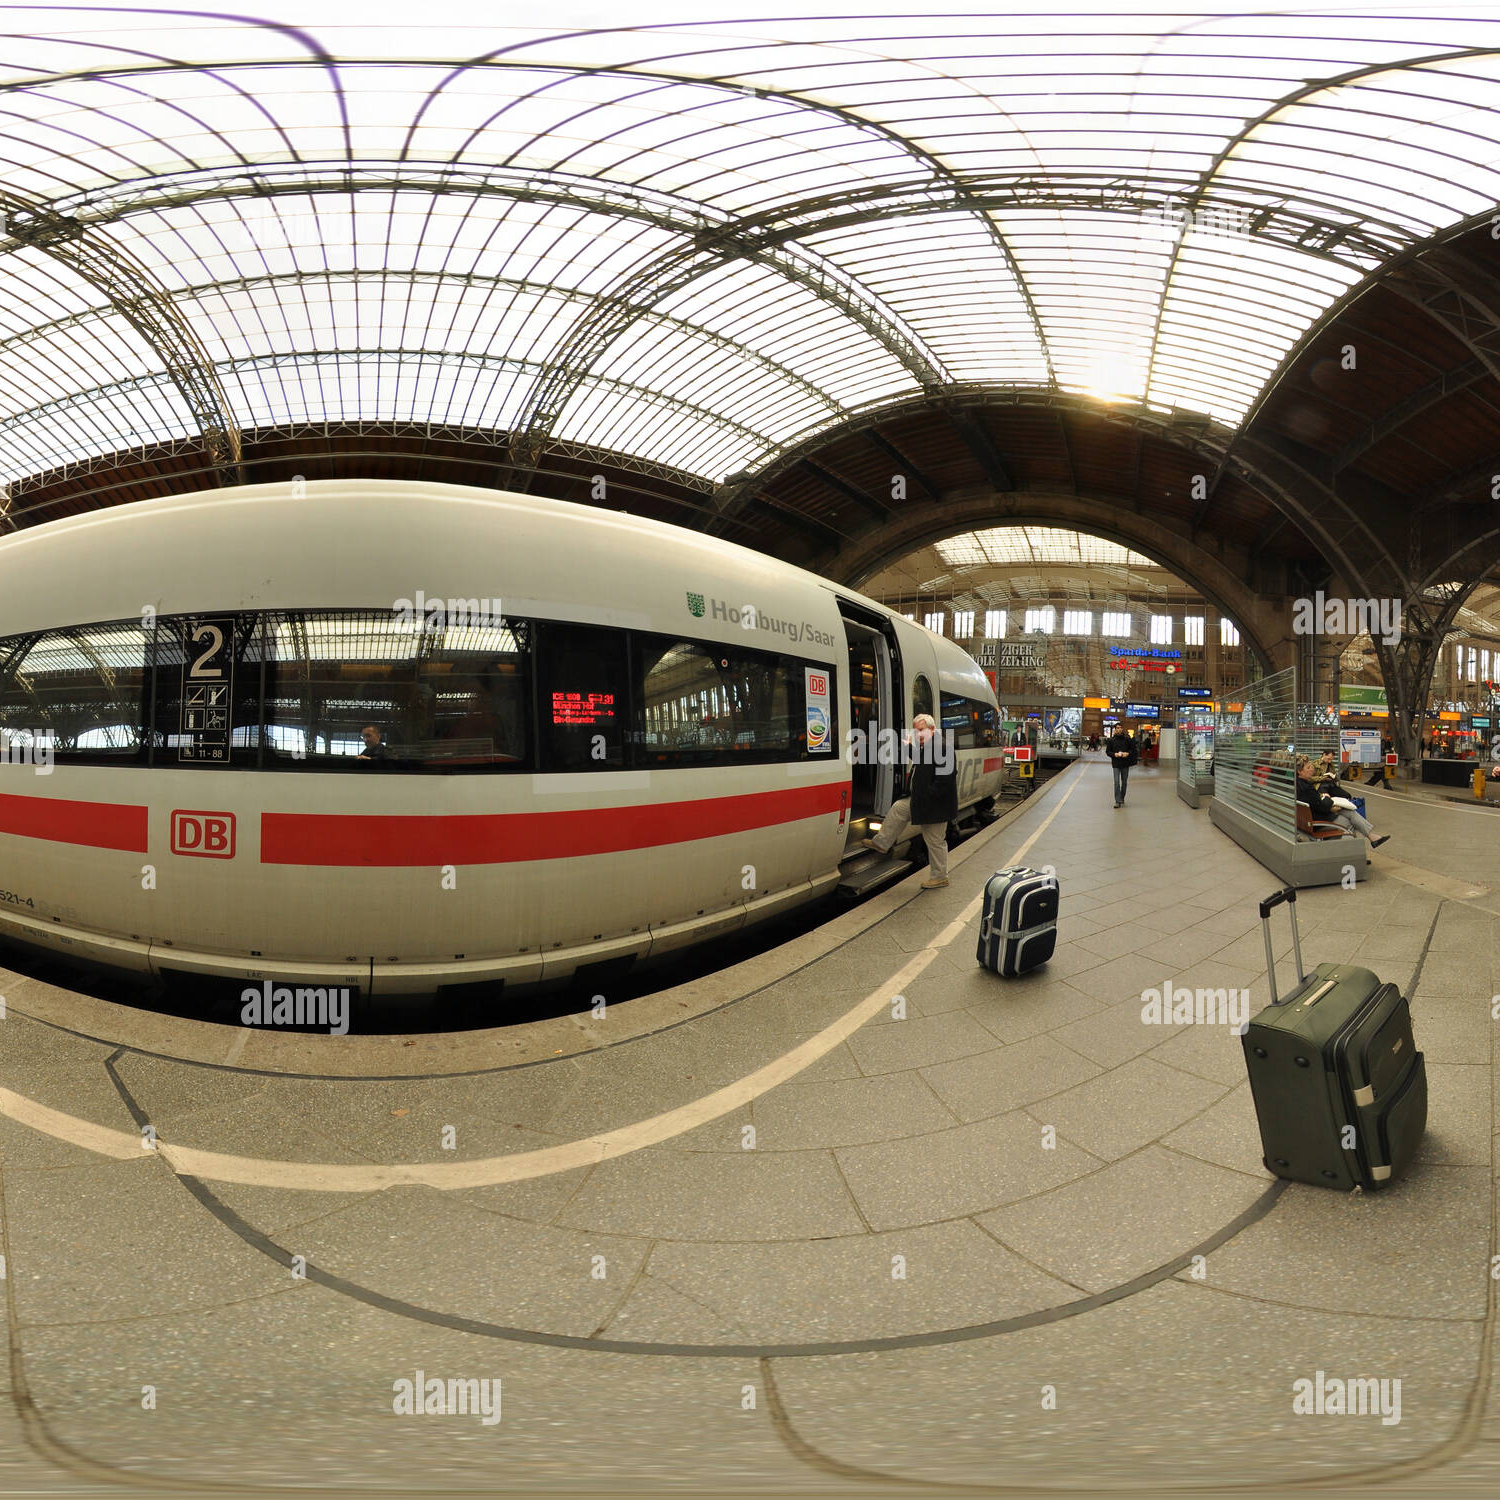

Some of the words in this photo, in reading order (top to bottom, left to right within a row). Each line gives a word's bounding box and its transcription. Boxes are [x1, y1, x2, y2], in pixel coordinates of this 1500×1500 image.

[189, 624, 223, 678] 2
[981, 643, 1033, 656] LEIZIGER
[811, 678, 825, 693] DB
[177, 815, 230, 852] DB
